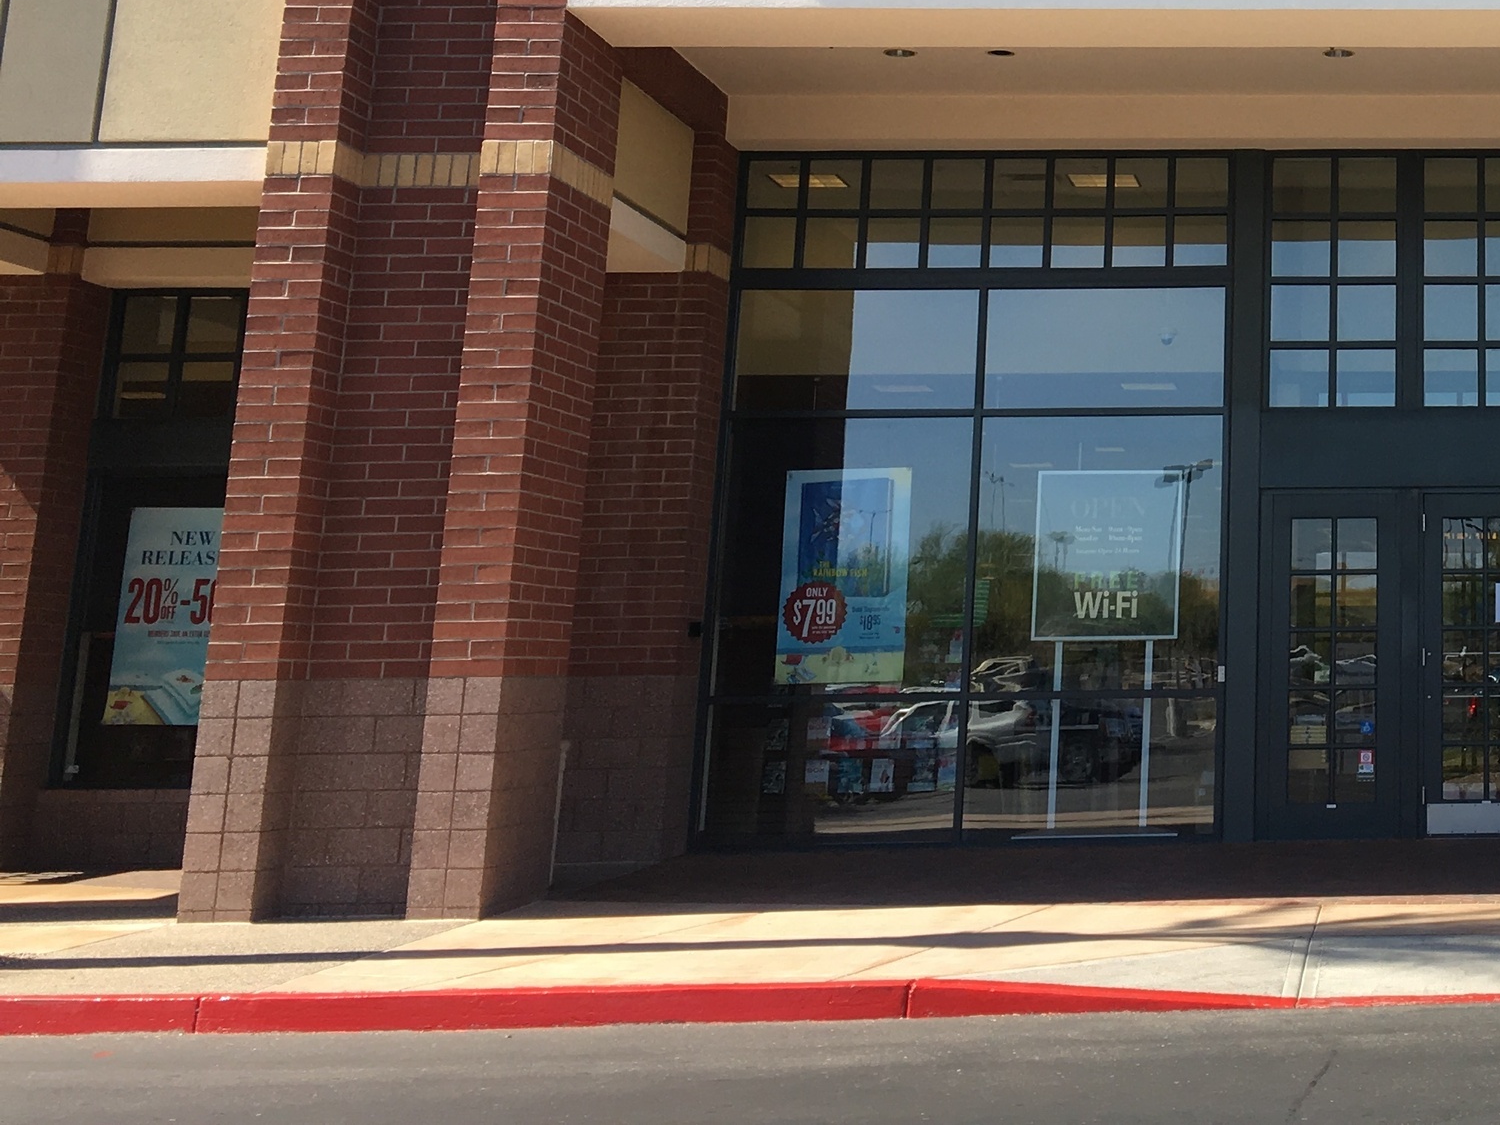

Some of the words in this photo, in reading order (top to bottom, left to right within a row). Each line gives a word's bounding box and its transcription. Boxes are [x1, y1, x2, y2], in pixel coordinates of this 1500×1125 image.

[1070, 496, 1145, 519] OPEN
[170, 530, 216, 546] NEW
[141, 550, 219, 566] RELEAS
[812, 568, 848, 577] RAINBOW
[849, 568, 868, 577] FISH
[1073, 571, 1139, 589] FREE
[806, 587, 829, 597] ONLY
[160, 605, 177, 619] OFF
[1073, 590, 1139, 619] Wi-Fi
